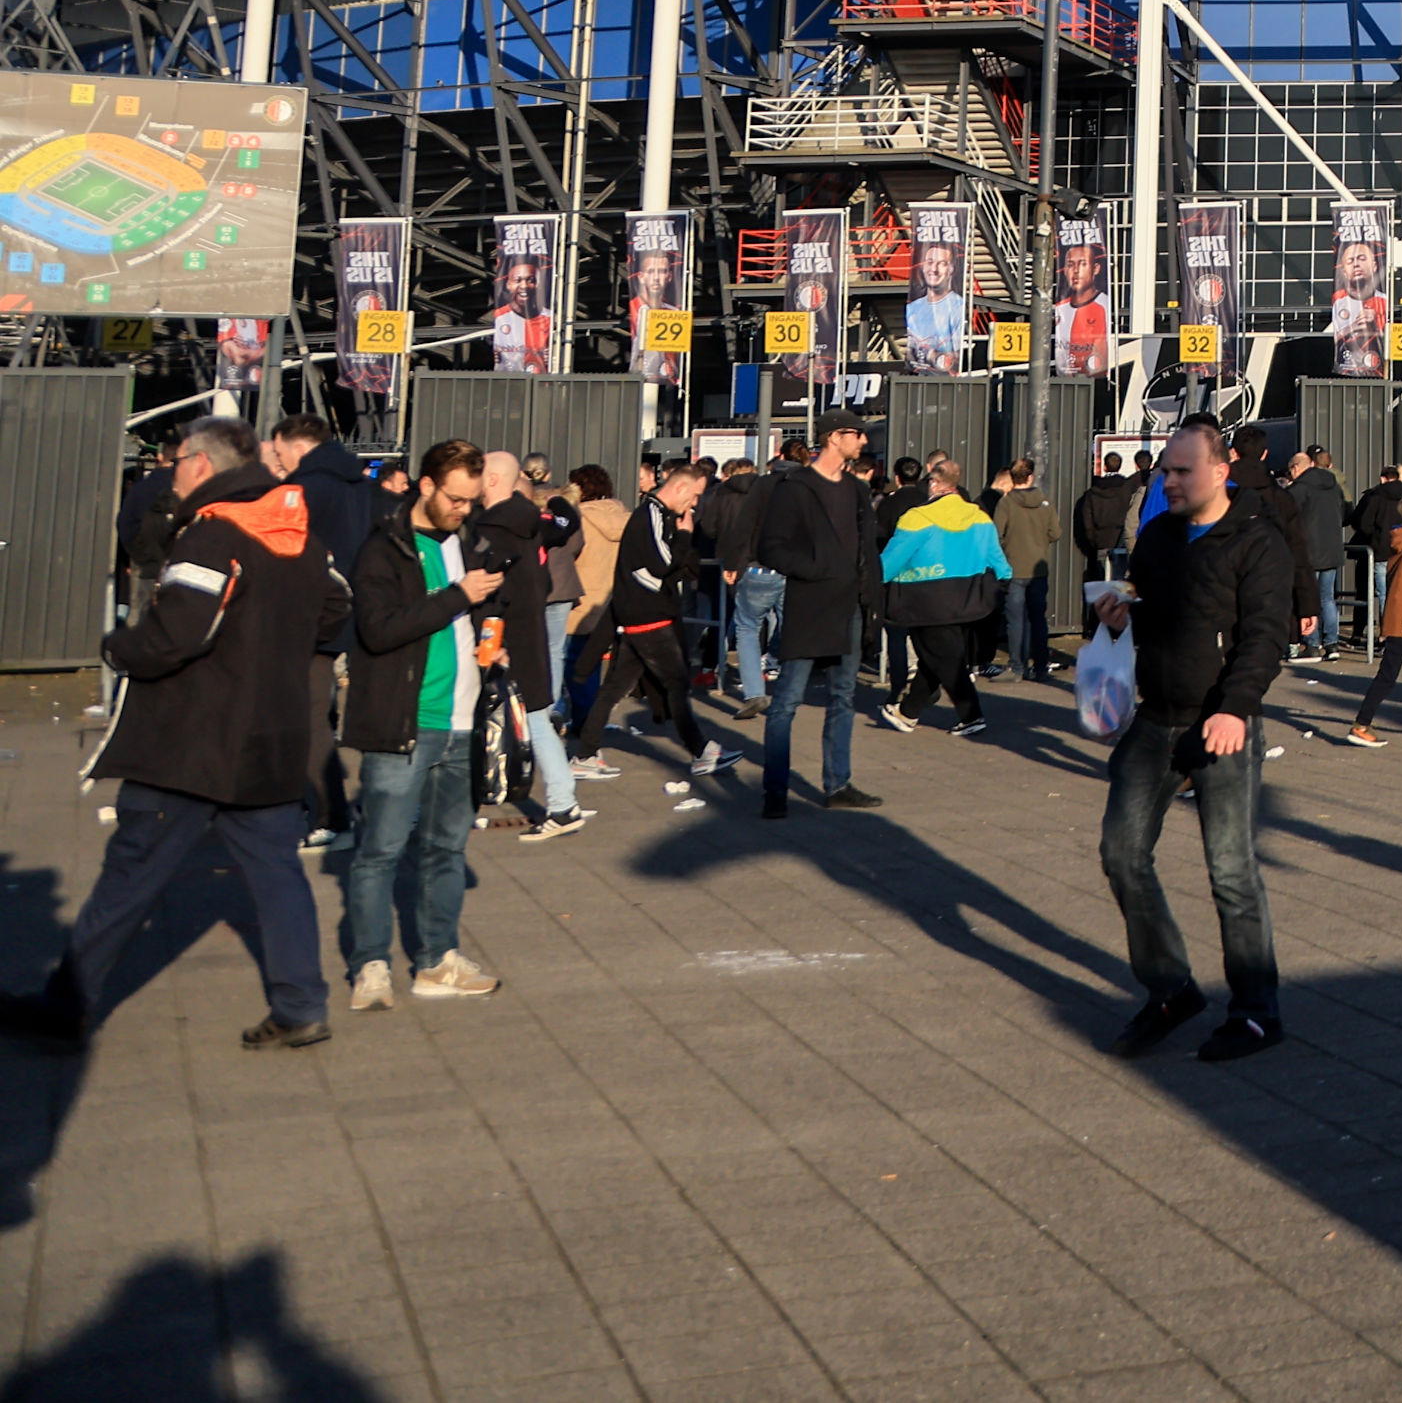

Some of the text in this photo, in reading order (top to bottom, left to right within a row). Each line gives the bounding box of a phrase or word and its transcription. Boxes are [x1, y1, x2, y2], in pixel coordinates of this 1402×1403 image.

[112, 319, 144, 341] 27
[367, 322, 396, 343] 28
[654, 322, 684, 342] 29
[773, 324, 801, 343] 30
[1002, 333, 1023, 352] 31
[1187, 335, 1210, 353] 32
